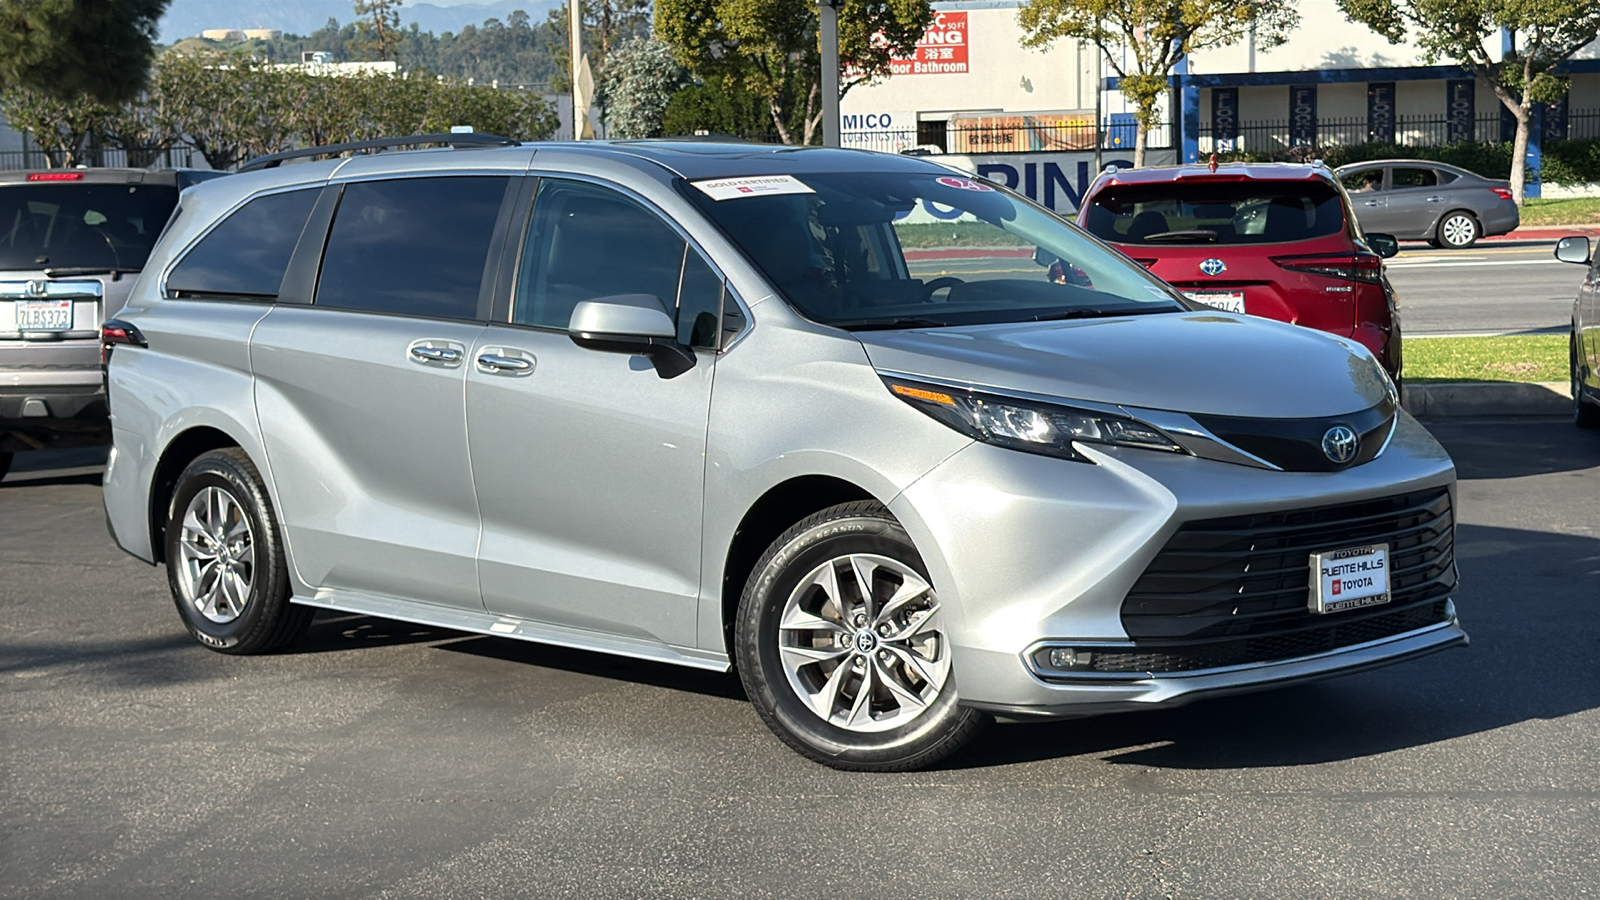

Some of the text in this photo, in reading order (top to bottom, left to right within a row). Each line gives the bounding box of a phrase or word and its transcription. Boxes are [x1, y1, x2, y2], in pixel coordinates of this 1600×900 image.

[946, 22, 956, 30] SQ
[914, 61, 967, 73] Bathroom
[843, 113, 892, 129] MICO
[843, 131, 890, 143] LOGISTICS
[706, 177, 789, 189] GOLD CERTIFIED
[20, 310, 68, 324] 7LBS373
[1321, 559, 1383, 577] PUENTE HILLS
[1343, 577, 1373, 590] TOYOTA
[1326, 595, 1387, 612] PUENTE HILLS
